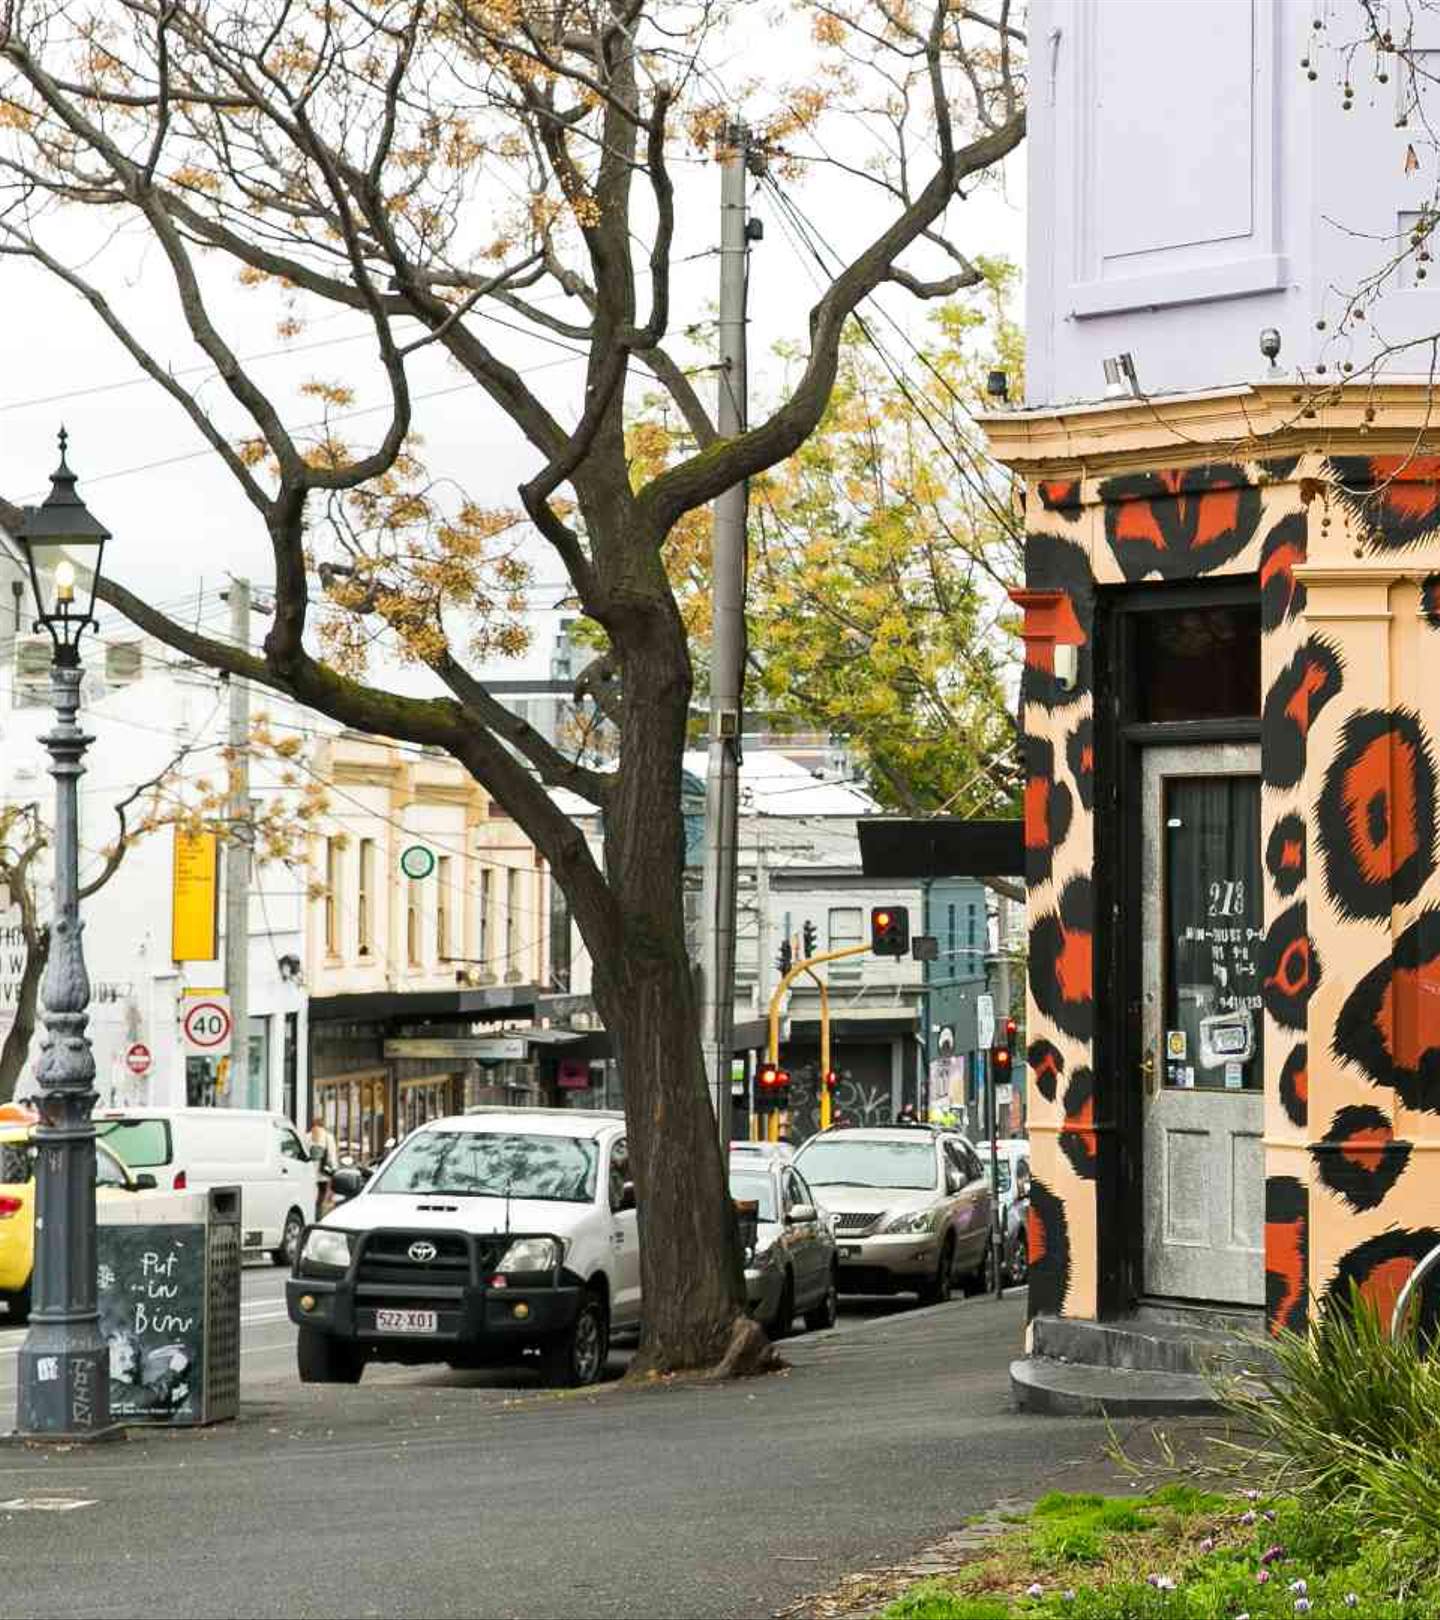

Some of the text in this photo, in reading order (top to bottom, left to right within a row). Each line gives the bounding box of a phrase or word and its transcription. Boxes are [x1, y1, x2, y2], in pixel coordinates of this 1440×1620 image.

[193, 1015, 222, 1034] 40
[141, 1252, 178, 1276] Put
[135, 1303, 192, 1334] Bin
